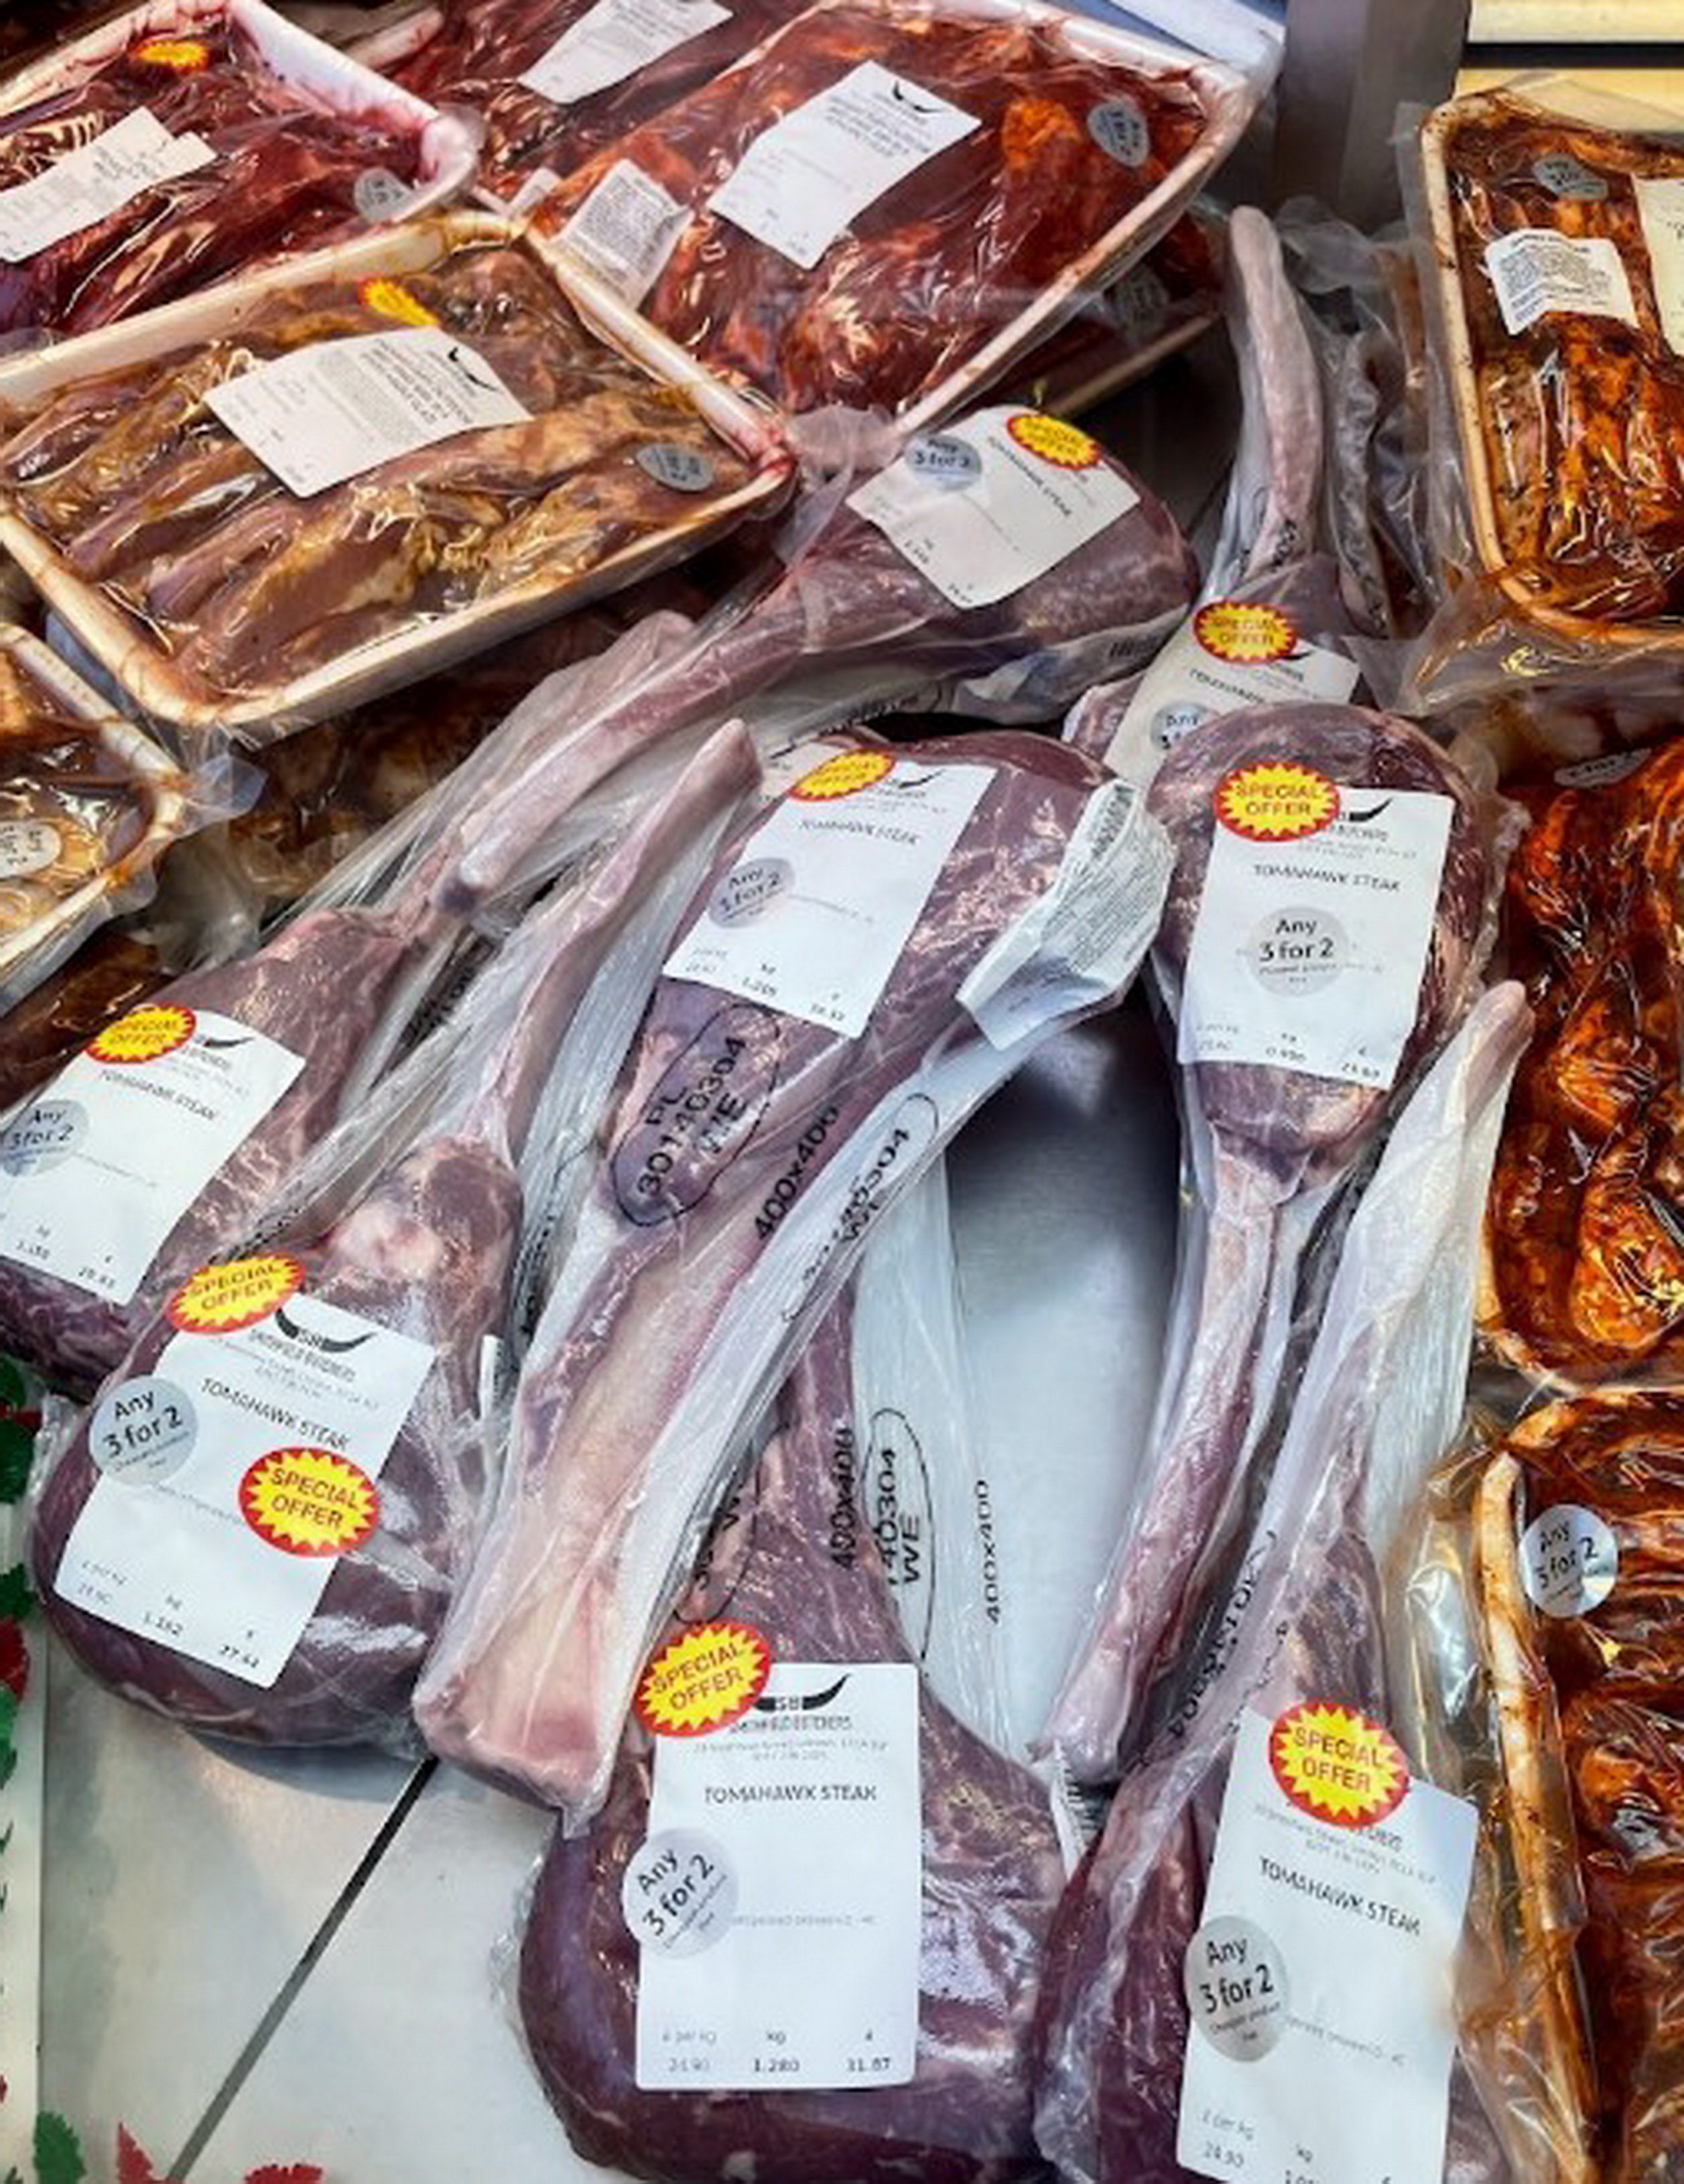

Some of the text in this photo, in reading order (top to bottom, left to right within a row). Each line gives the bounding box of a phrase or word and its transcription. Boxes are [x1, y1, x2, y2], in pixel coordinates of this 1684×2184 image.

[1236, 783, 1323, 800] SPECIAL
[1244, 801, 1311, 816] OFFER
[734, 881, 771, 905] for
[768, 872, 783, 889] 2
[1254, 864, 1401, 893] TOMAHAWK STEAK
[1275, 917, 1317, 936] Any
[1258, 938, 1334, 963] 3 for 2
[58, 1122, 74, 1141] 2
[754, 1106, 838, 1240] 400x400
[188, 1263, 277, 1296] SPECIAL
[200, 1281, 274, 1311] OFFER
[113, 1389, 155, 1421] Any
[200, 1378, 350, 1452] TOMAHAWK STEAK
[102, 1406, 185, 1458] 3 for 2
[269, 1466, 361, 1512] SPECIAL
[828, 1427, 858, 1571] 400x400
[271, 1495, 344, 1529] OFFER
[901, 1515, 920, 1584] WE
[975, 1480, 1001, 1625] 400x400
[1579, 1536, 1599, 1559] 2
[653, 1642, 745, 1693] SPECIAL
[669, 1667, 744, 1711] OFFER
[1295, 1726, 1384, 1769] SPECIAL
[1301, 1757, 1372, 1793] OFFER
[705, 1784, 877, 1806] TOMAHAWK STEAK
[637, 1848, 679, 1895] Any
[642, 1854, 715, 1936] 3 for 2
[1259, 1856, 1421, 1936] TOMAHAWK STEAK
[1206, 1937, 1248, 1969] Any
[1200, 1964, 1275, 2014] 3 for 2
